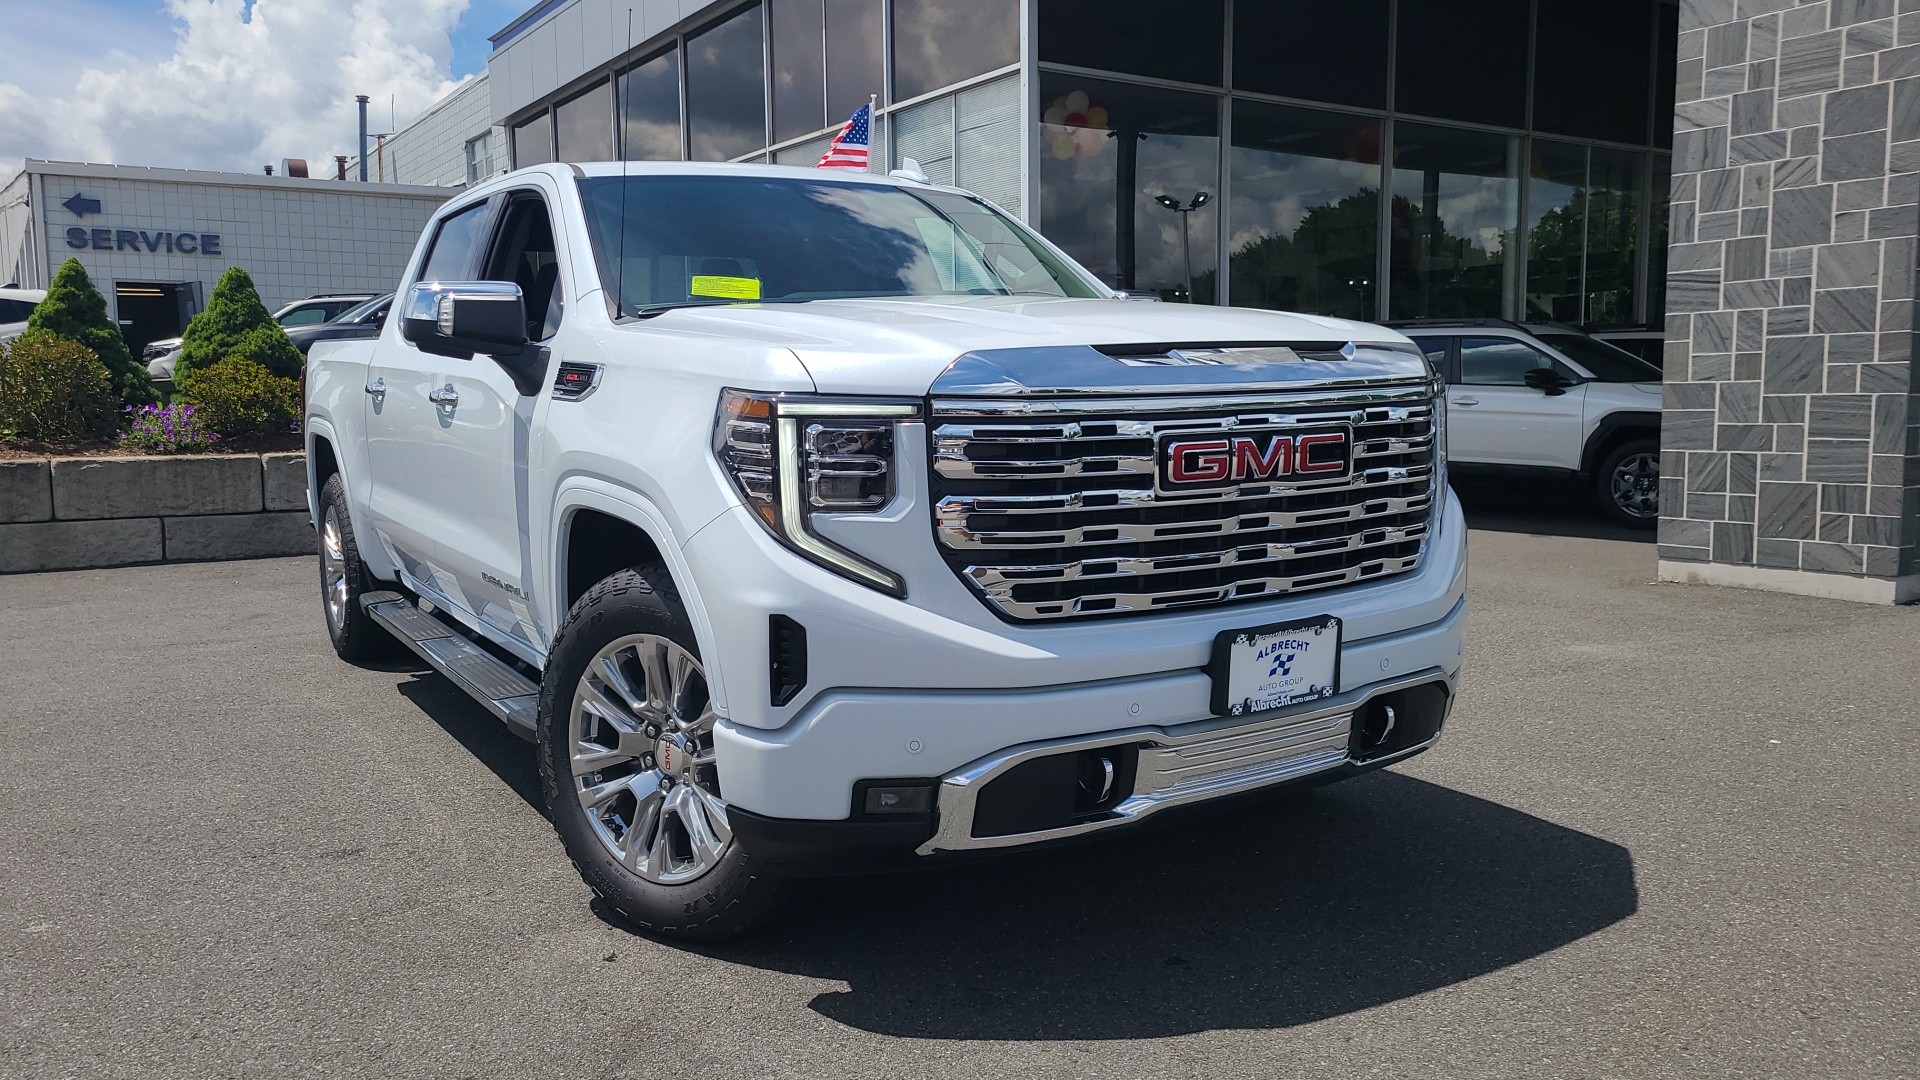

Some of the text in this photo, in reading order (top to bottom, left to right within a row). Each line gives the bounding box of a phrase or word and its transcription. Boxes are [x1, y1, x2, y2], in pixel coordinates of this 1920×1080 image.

[66, 227, 222, 255] SERVICE
[1168, 432, 1345, 484] GMC
[1256, 639, 1310, 662] ALBRECHT
[1258, 677, 1304, 692] AUTO GROUP
[1251, 694, 1292, 712] Albrecht
